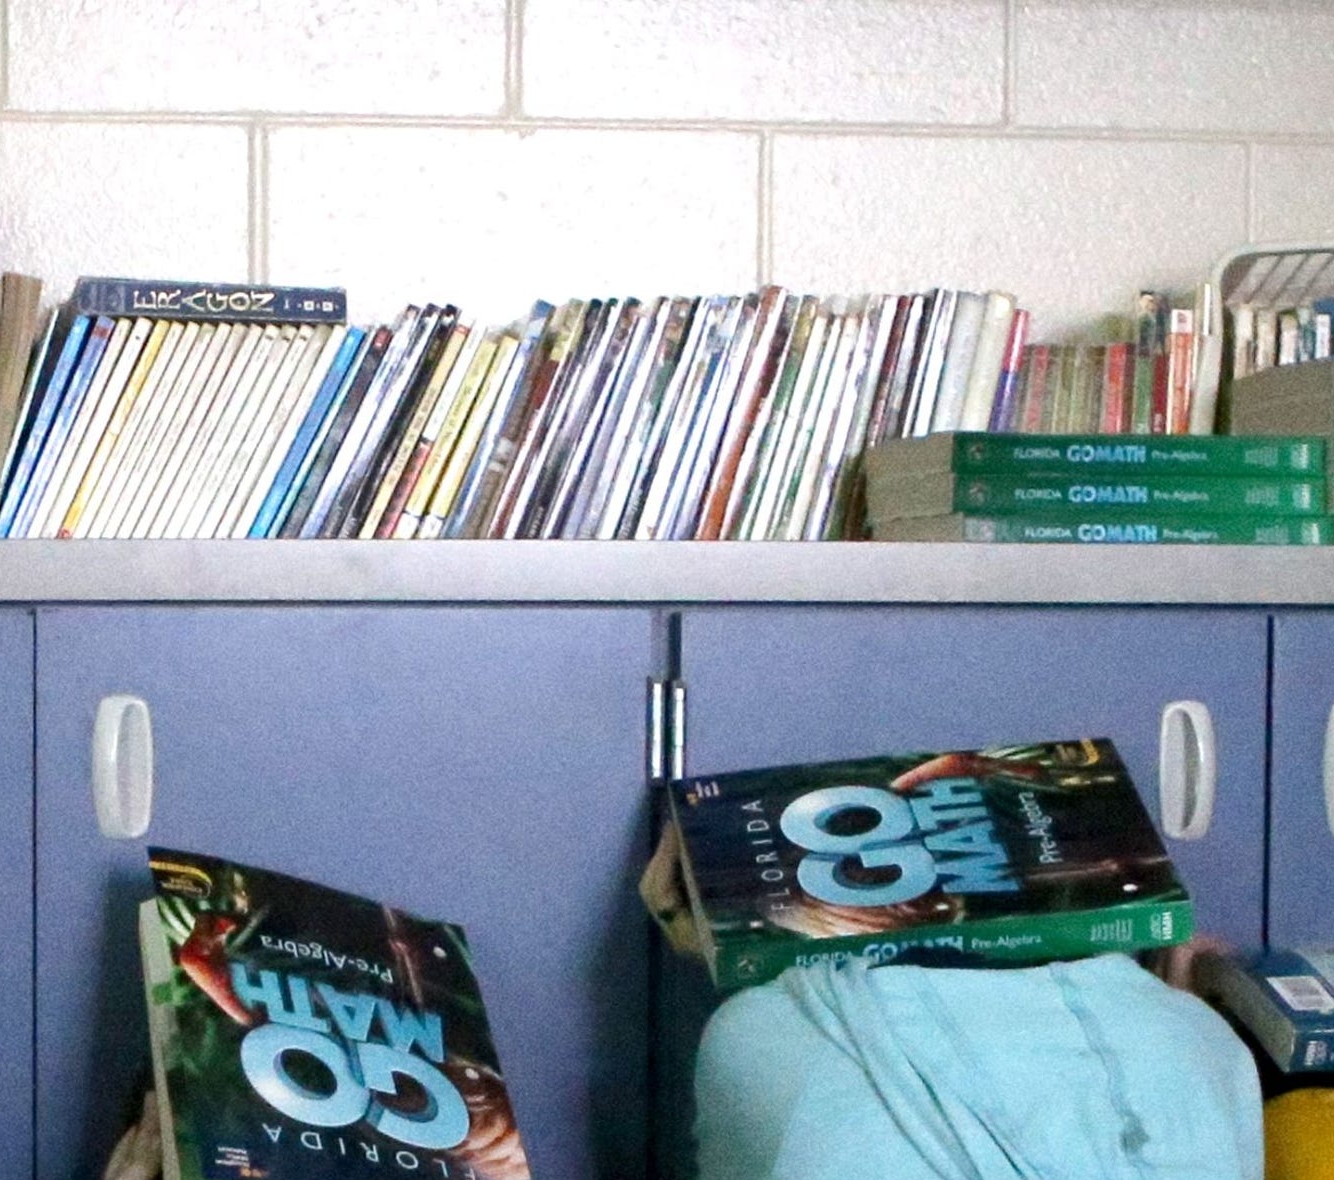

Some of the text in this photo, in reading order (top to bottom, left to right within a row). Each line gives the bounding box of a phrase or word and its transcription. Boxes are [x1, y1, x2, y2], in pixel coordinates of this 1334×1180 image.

[133, 290, 275, 312] ERAGON
[1014, 448, 1060, 459] FLORIDA
[1016, 489, 1062, 500] FLORIDA
[1024, 528, 1072, 538] FLORIDA
[741, 799, 792, 912] FLORIDA
[780, 785, 938, 907] GO
[909, 777, 1020, 892] MATH
[1018, 790, 1061, 864] Pre-Algebra
[260, 934, 394, 985] Pre-Algebra
[971, 934, 1042, 949] Pre-Algebra
[229, 958, 444, 1063] MATH
[240, 1022, 470, 1150] GO
